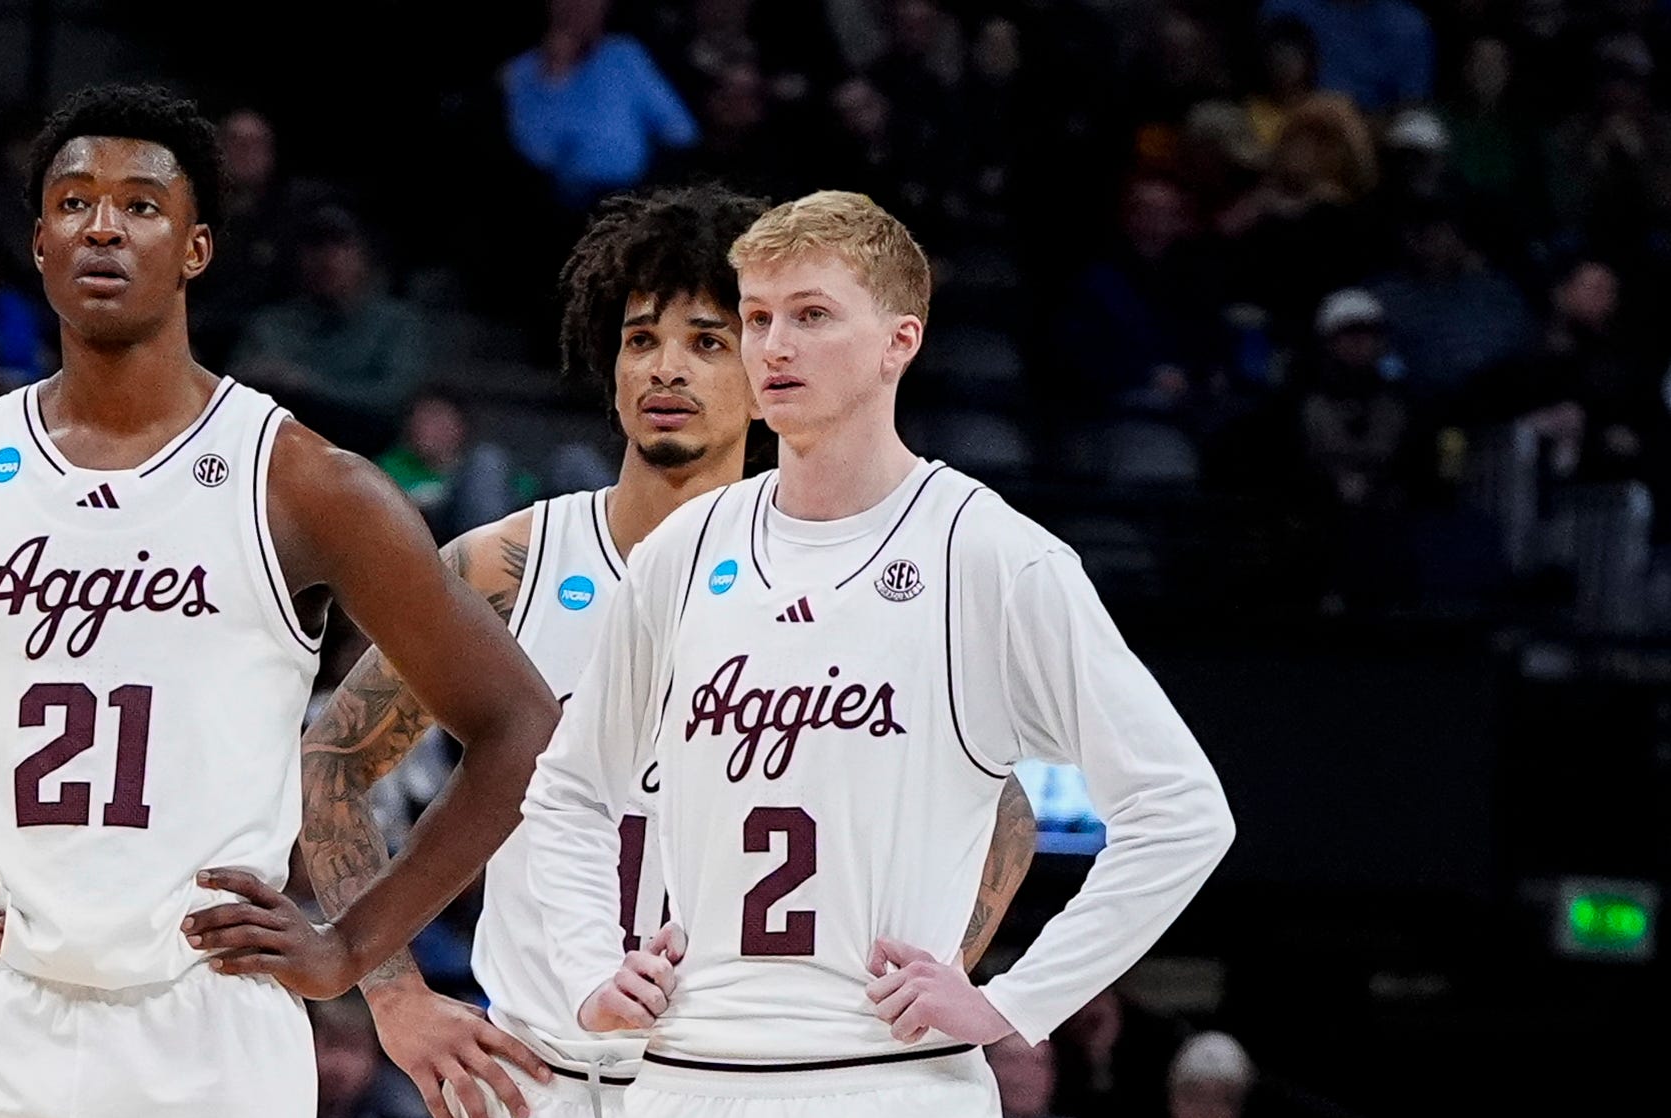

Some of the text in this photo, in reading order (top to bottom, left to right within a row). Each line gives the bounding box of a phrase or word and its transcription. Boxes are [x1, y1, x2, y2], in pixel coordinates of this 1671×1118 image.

[198, 457, 225, 483] SEC
[886, 562, 916, 590] SEC
[14, 682, 153, 829] 21
[685, 654, 908, 783] Aggies
[740, 806, 817, 956] 2
